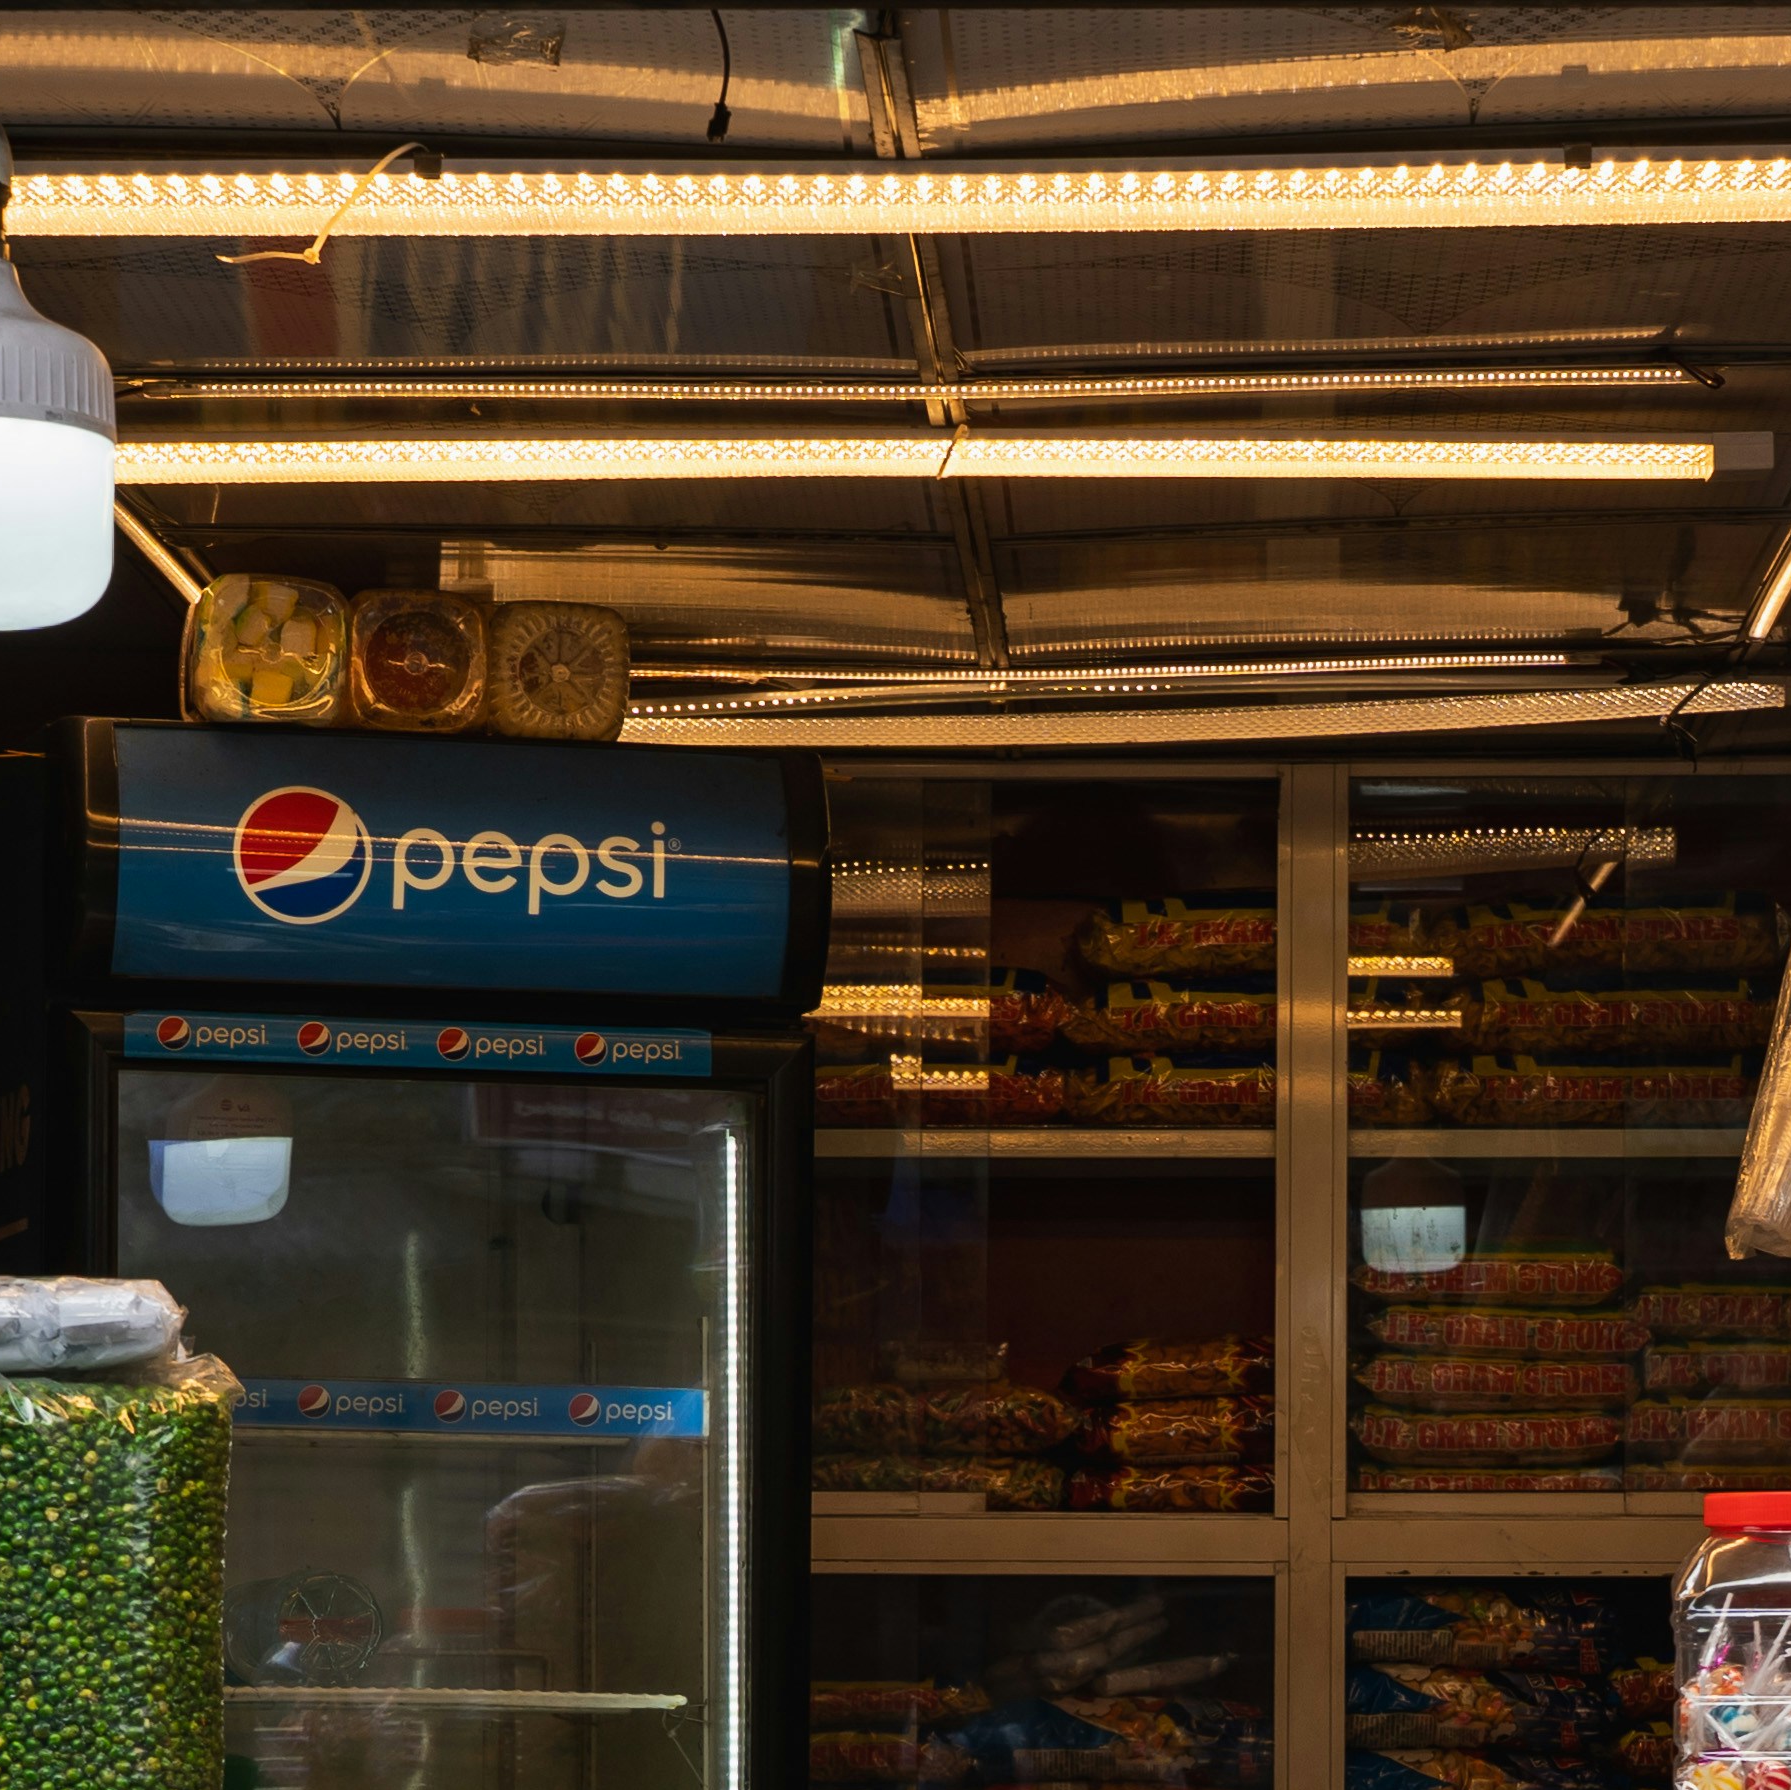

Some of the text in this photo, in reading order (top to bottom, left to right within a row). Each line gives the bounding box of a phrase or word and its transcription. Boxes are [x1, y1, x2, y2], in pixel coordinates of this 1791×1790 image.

[392, 821, 666, 916] pepsi
[196, 1024, 266, 1049] pepsi
[336, 1030, 406, 1054] pepsi
[475, 1035, 544, 1059] pepsi
[612, 1040, 680, 1063] pepsi
[1443, 1316, 1528, 1349] GRAM
[1431, 1363, 1517, 1393] GRAM
[335, 1393, 403, 1416] pepsi
[471, 1396, 539, 1420] pepsi
[606, 1400, 672, 1425] pepsi
[1417, 1419, 1500, 1450] GRAM
